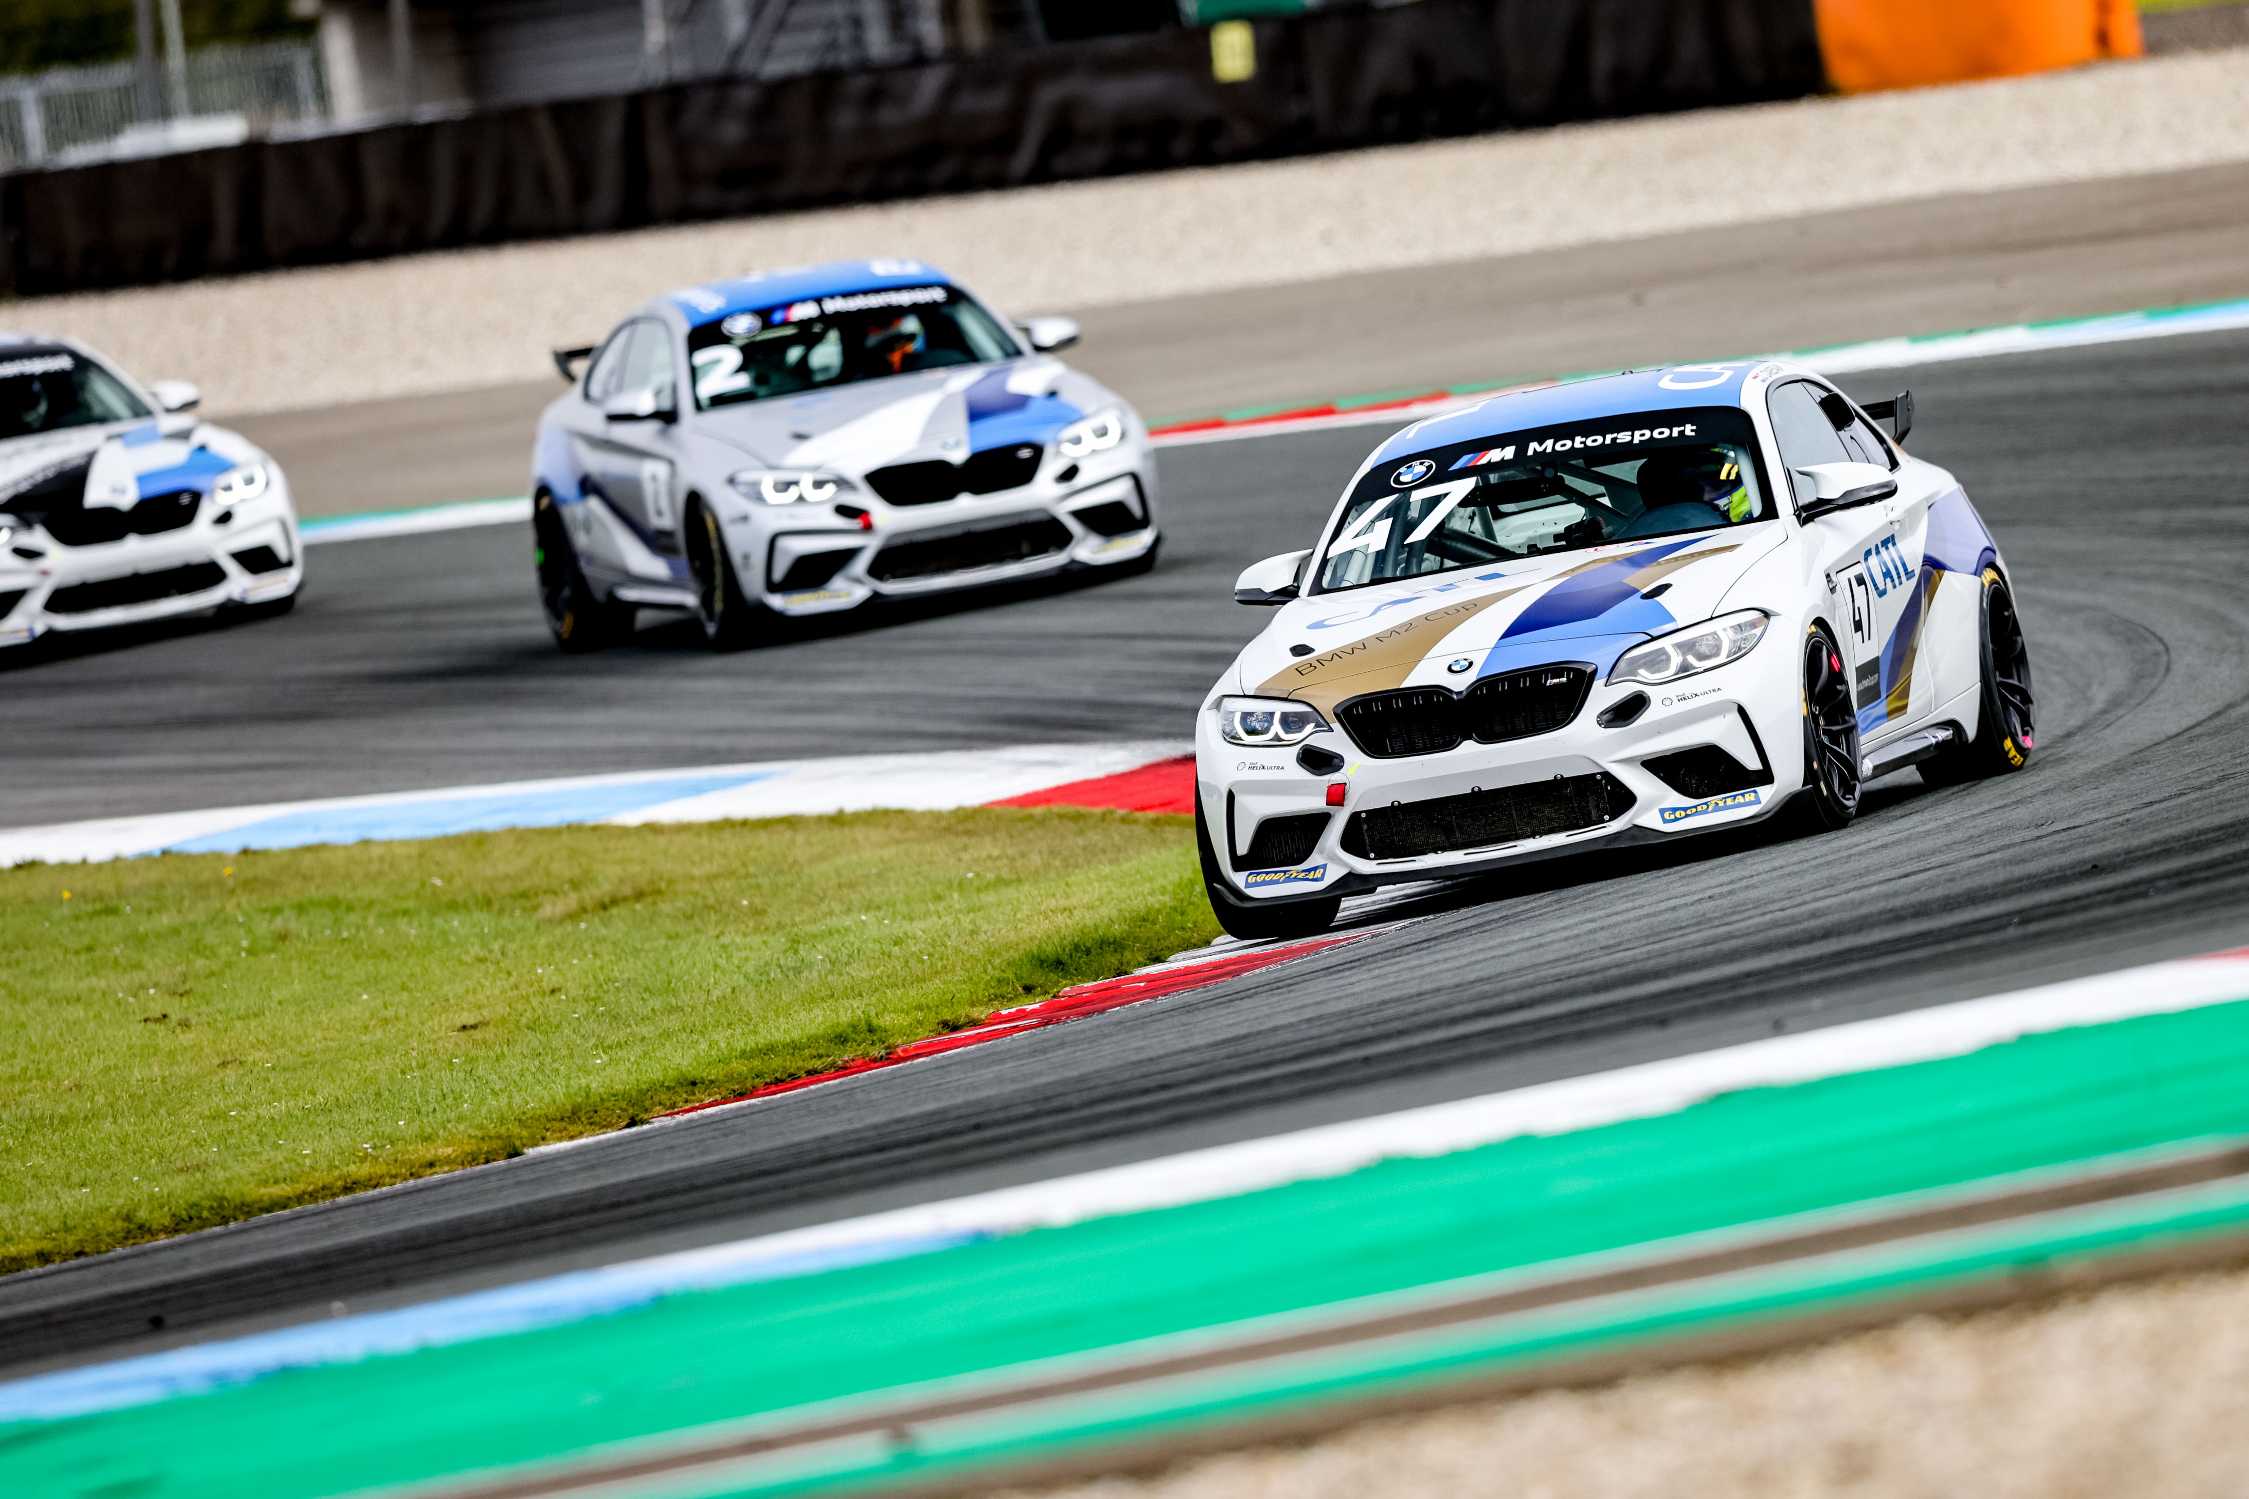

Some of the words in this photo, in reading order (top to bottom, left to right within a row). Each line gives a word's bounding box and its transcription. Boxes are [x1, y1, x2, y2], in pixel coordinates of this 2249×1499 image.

[691, 344, 750, 399] 2
[1527, 424, 1697, 456] Motorsport
[1327, 477, 1477, 559] 47
[1863, 533, 1915, 598] CATL
[1848, 572, 1871, 643] 47
[1295, 642, 1367, 677] BMW
[1376, 623, 1417, 643] M2
[1425, 601, 1478, 622] CUP
[1663, 792, 1756, 820] GOODYEAR
[1247, 868, 1324, 884] GOODYEAR
